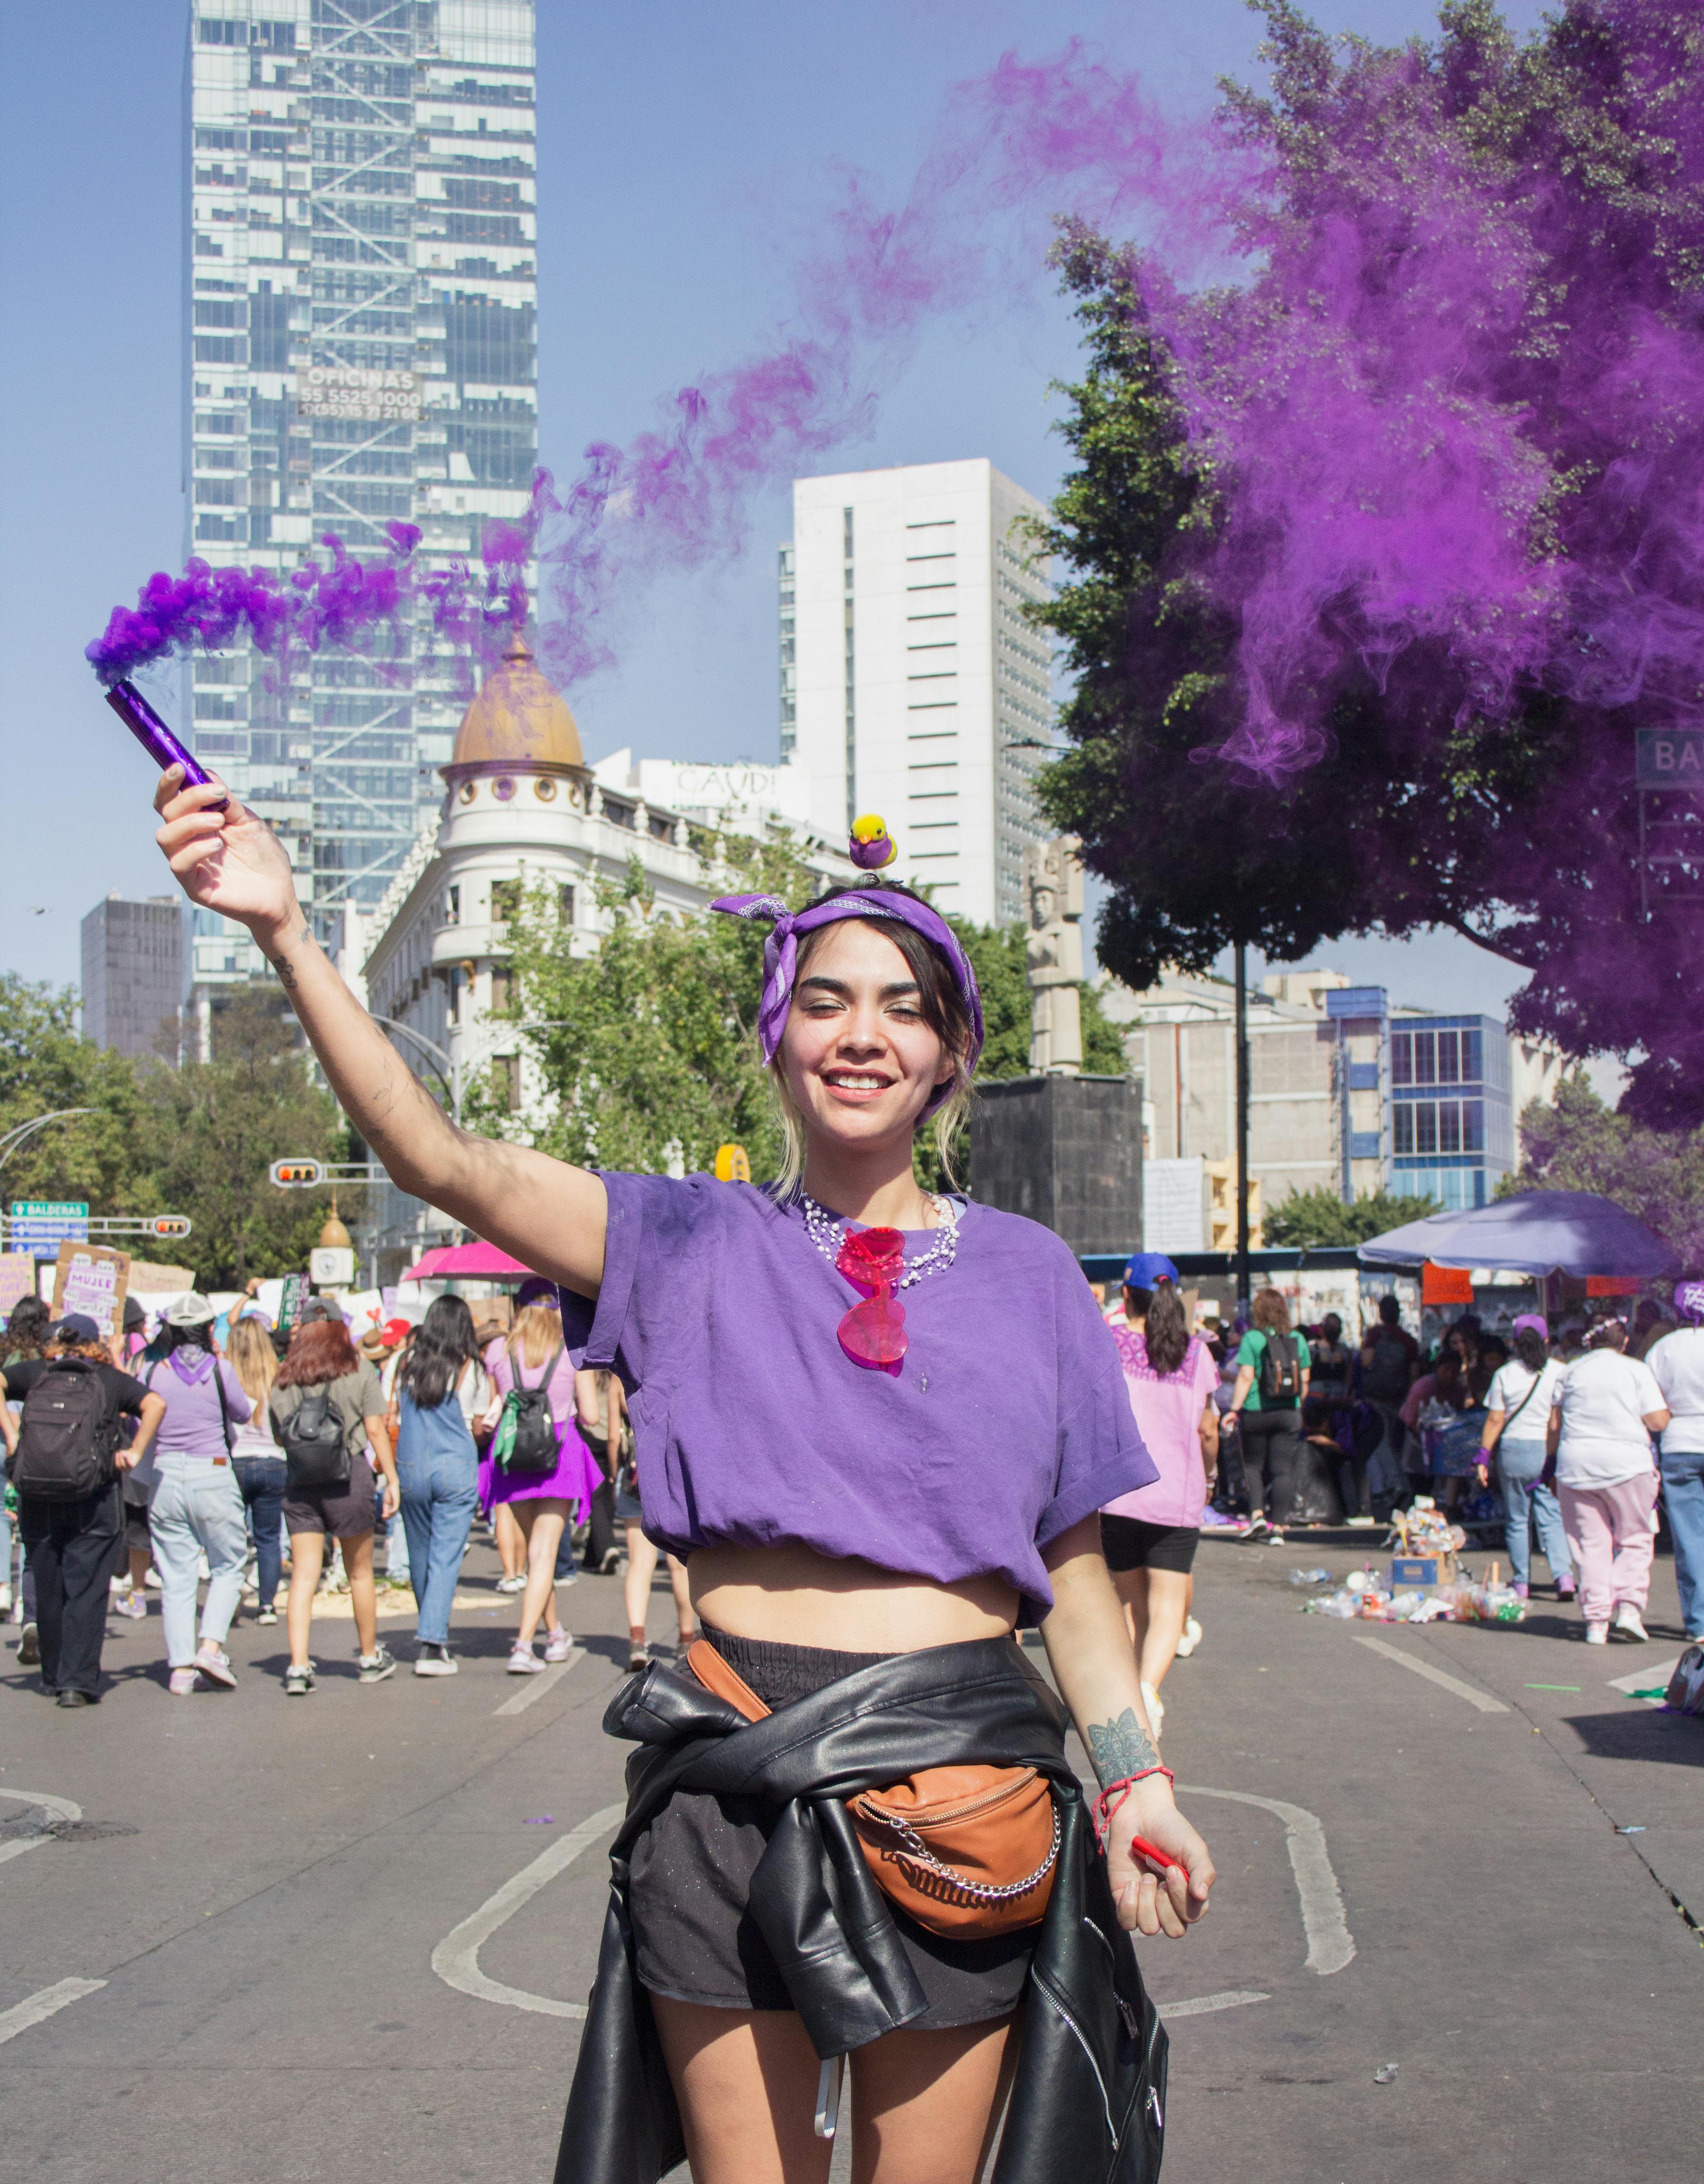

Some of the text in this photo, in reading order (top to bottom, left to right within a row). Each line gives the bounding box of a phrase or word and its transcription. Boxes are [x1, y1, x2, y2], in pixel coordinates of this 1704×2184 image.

[308, 368, 415, 389] OFICINAS
[300, 387, 422, 407] 55 5525 1000
[27, 1204, 82, 1216] BALDERAS
[71, 1274, 112, 1289] MUJER
